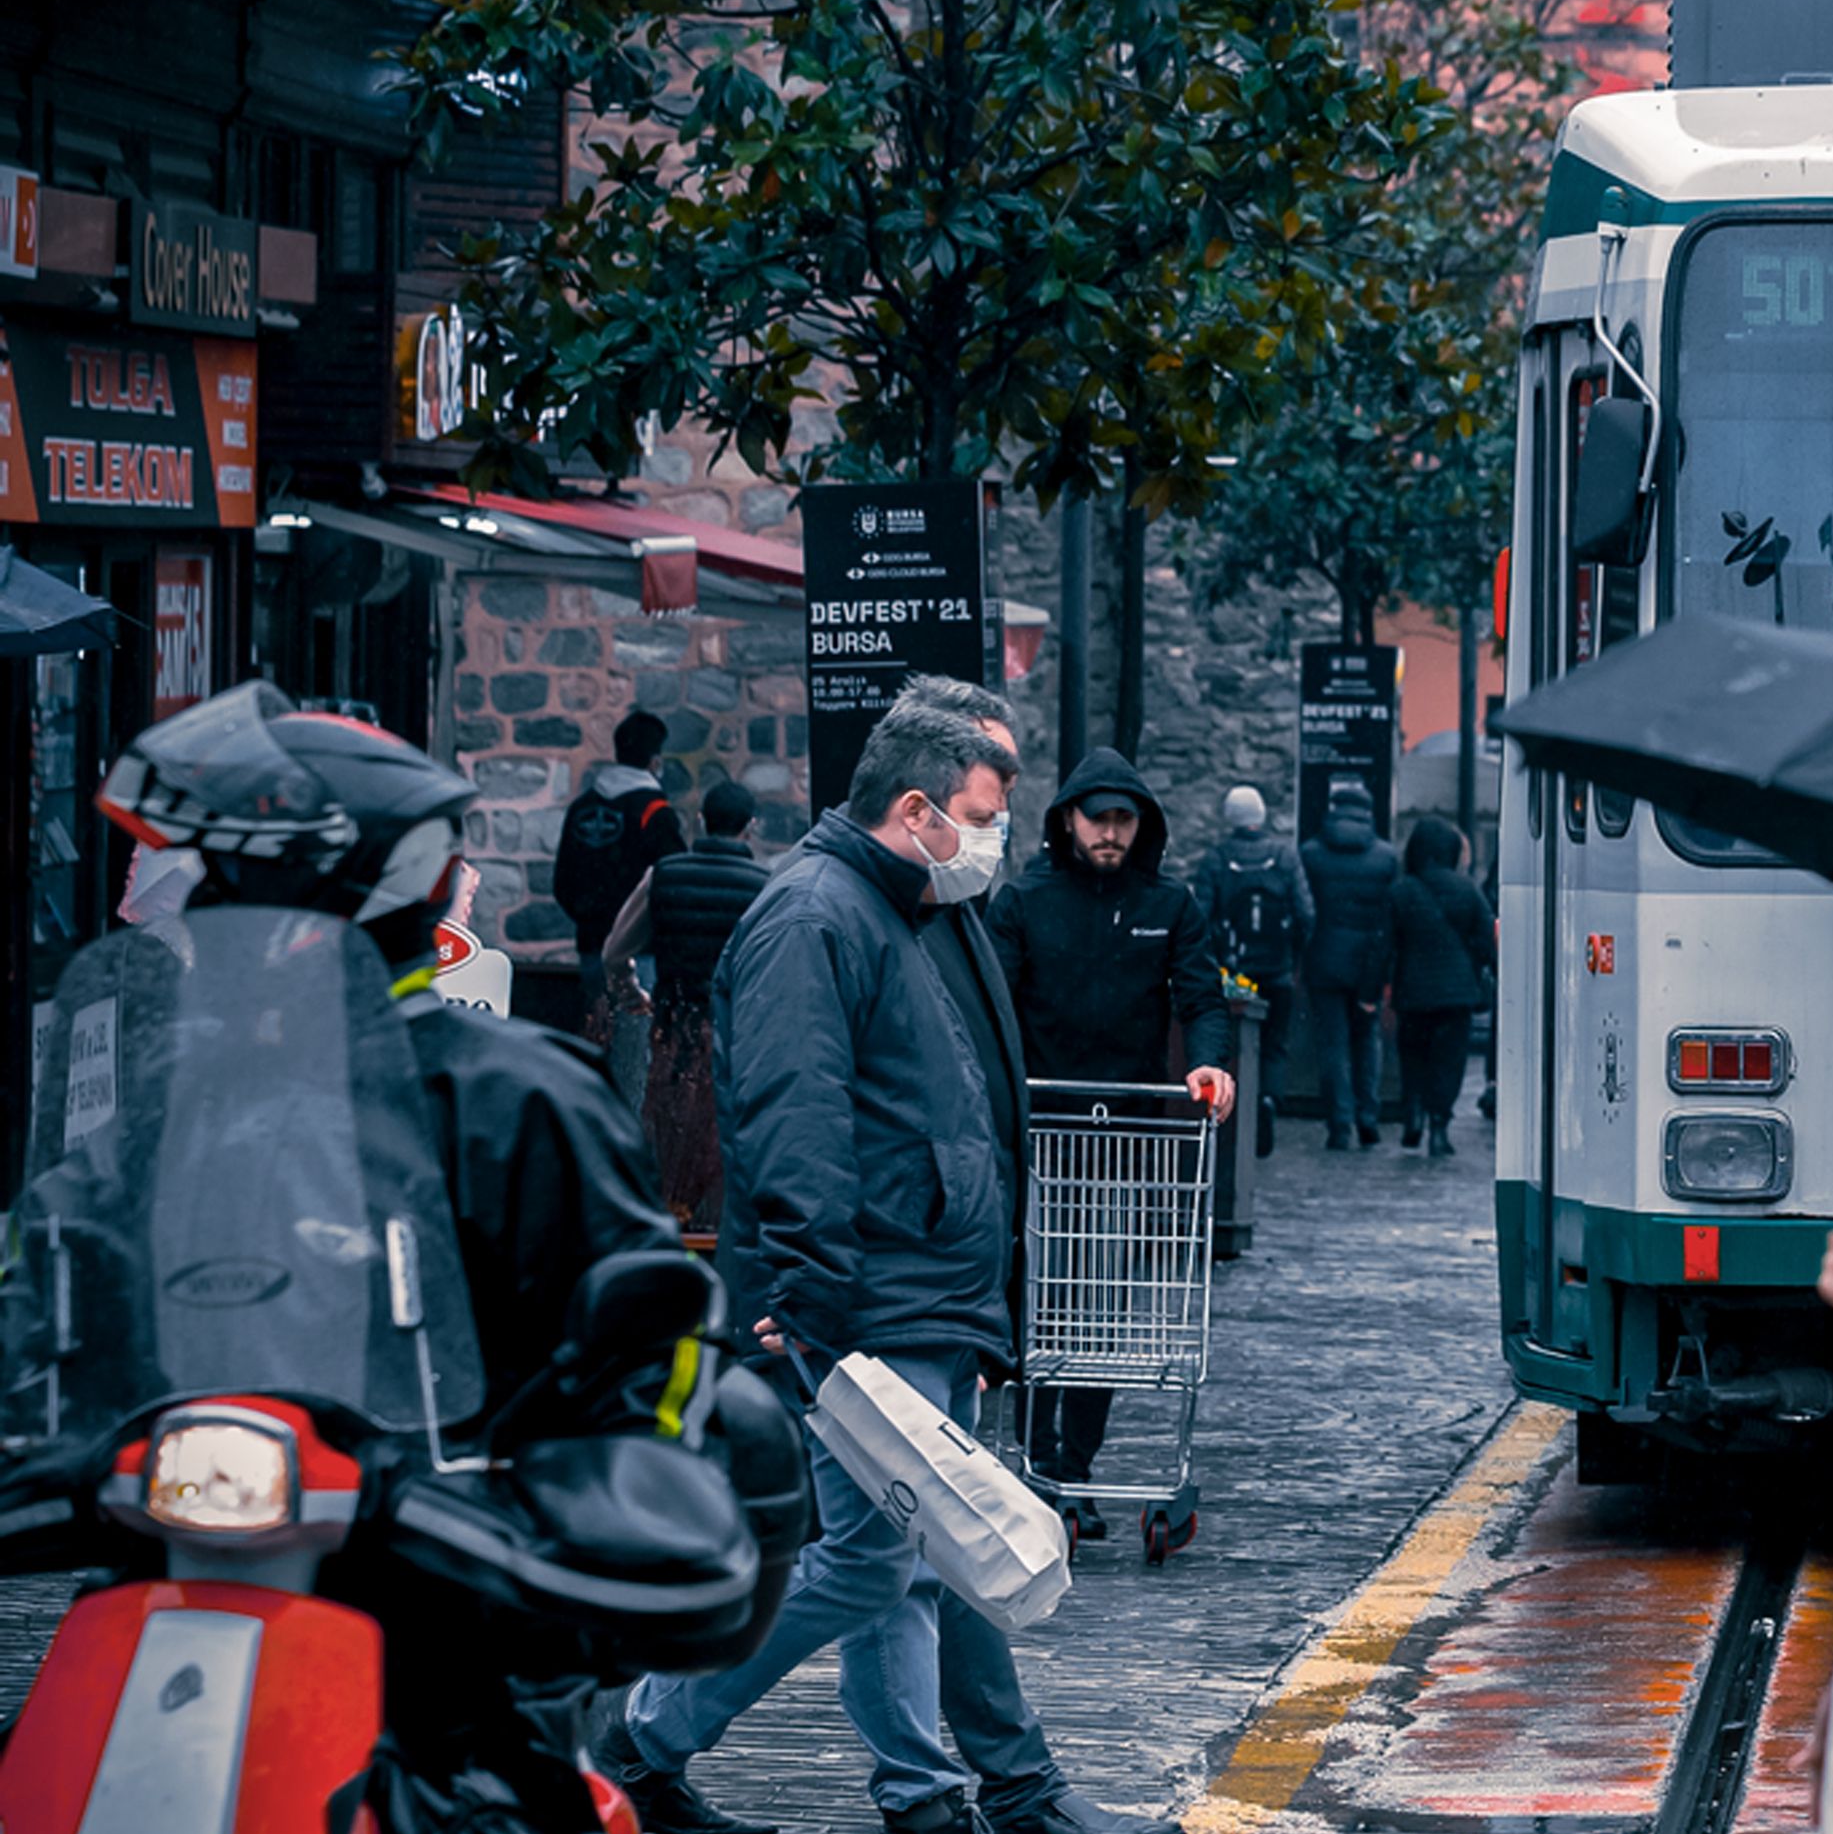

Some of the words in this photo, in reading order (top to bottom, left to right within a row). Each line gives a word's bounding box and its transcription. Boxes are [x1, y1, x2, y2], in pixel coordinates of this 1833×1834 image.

[144, 212, 193, 314] Cover
[197, 224, 250, 321] House
[66, 345, 176, 417] TOLGA
[43, 435, 194, 509] TELEKOM
[811, 630, 894, 655] BURSA
